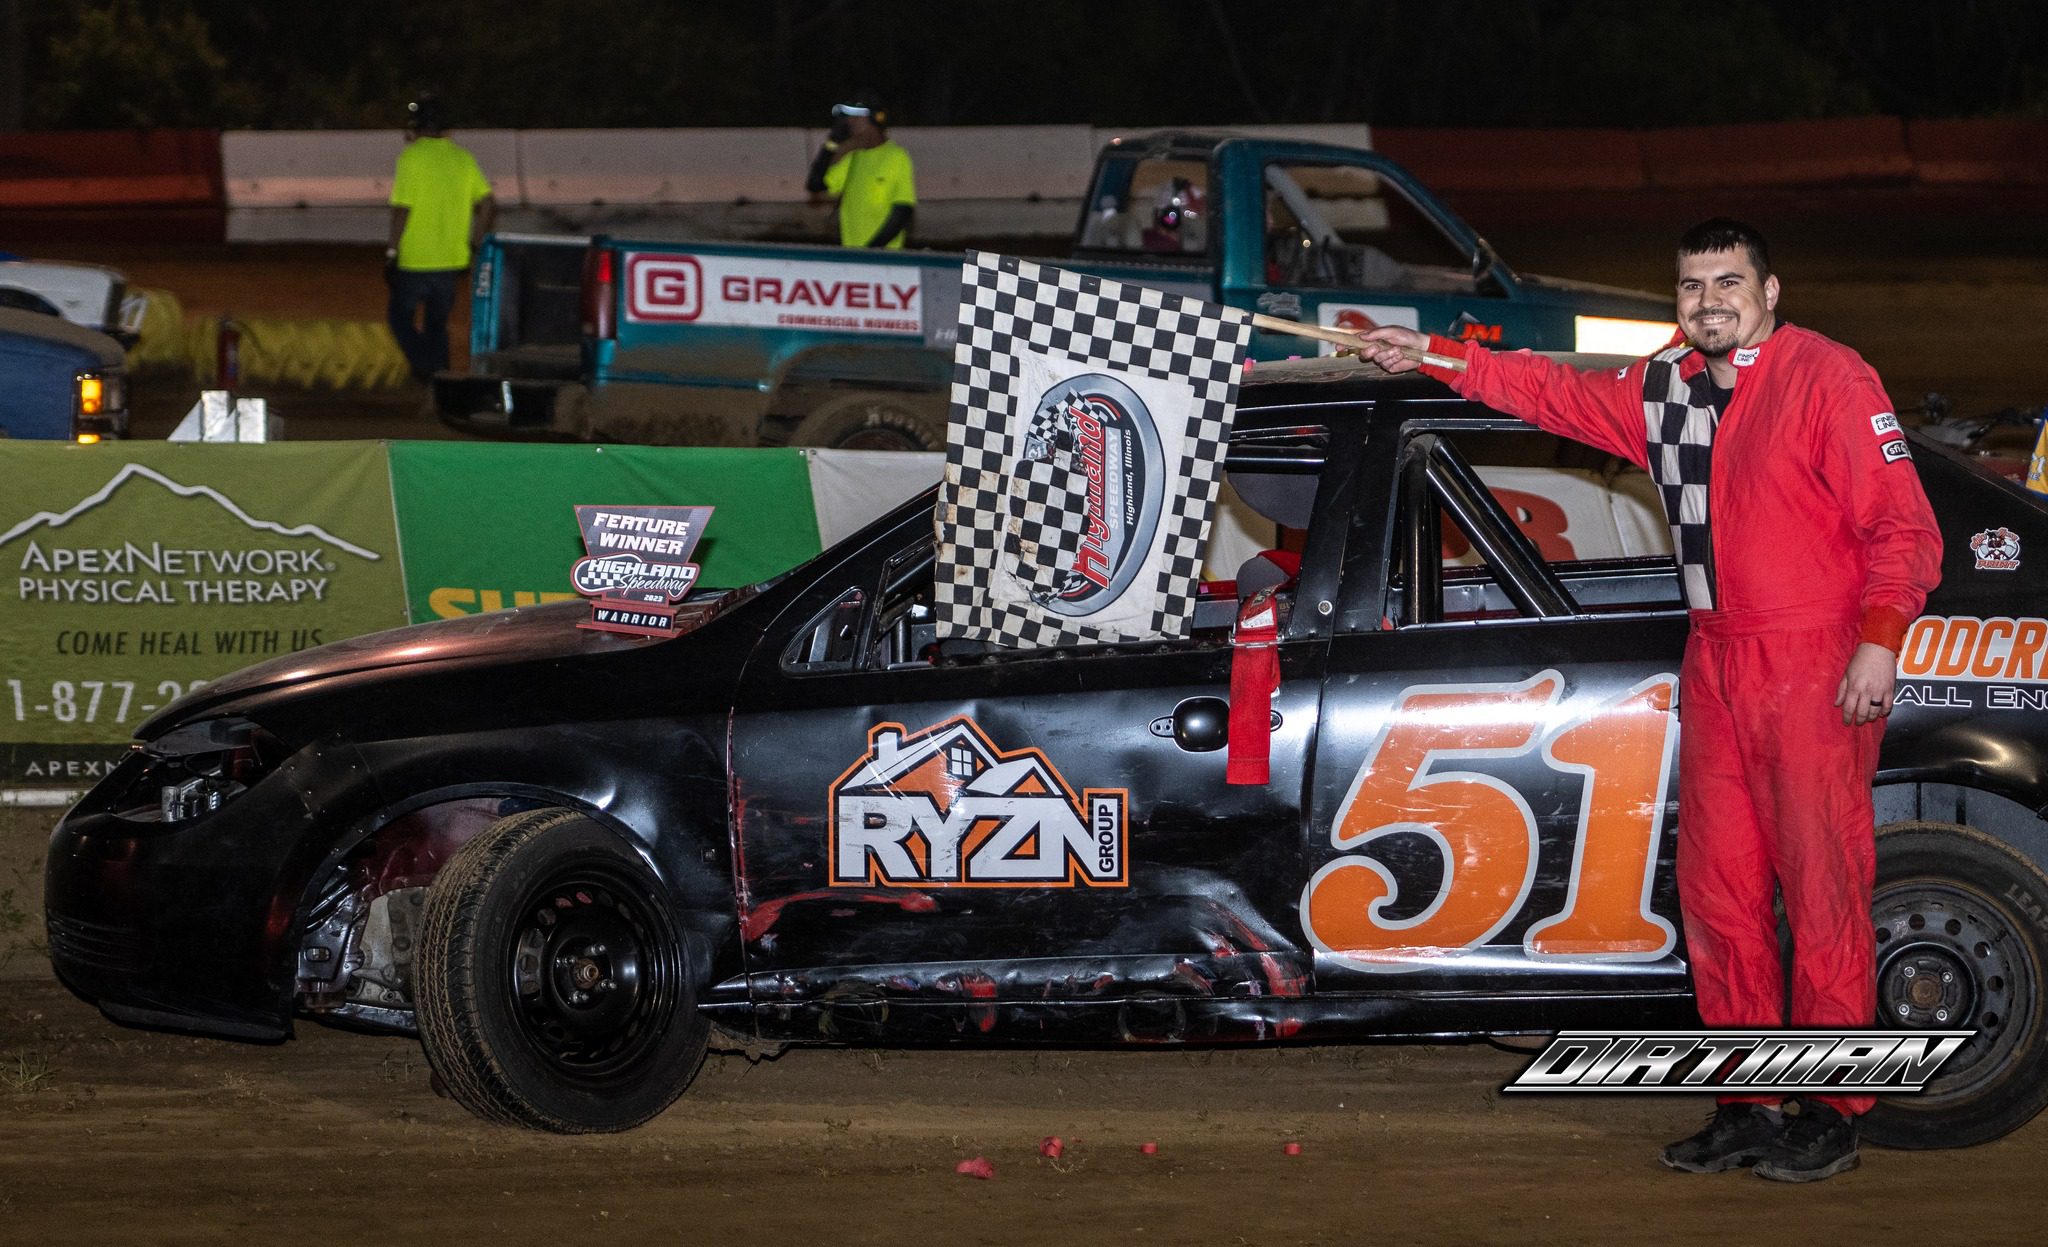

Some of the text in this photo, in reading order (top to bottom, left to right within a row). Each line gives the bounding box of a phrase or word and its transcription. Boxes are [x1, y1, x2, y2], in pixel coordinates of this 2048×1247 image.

[721, 275, 920, 311] GRAVELY
[777, 313, 920, 331] COMMERCIAL MOWERS
[1108, 430, 1119, 529] SPEEDWAY
[1123, 428, 1136, 526] Highland, Illinois
[593, 512, 690, 536] FEATURE
[599, 532, 685, 555] WINNER
[588, 559, 697, 579] HIGHLAND
[19, 576, 328, 603] PHYSICAL THERAPY
[616, 574, 690, 598] Speedway
[643, 594, 664, 603] 2023
[597, 609, 669, 628] WARRIOR
[57, 628, 323, 655] COME HEAL WITH US
[1895, 616, 2048, 681] ODCR
[8, 678, 209, 723] 1-877-2
[1893, 684, 2048, 710] ALL EN
[1300, 668, 1680, 974] 51
[838, 796, 1115, 878] RYZN GROUP
